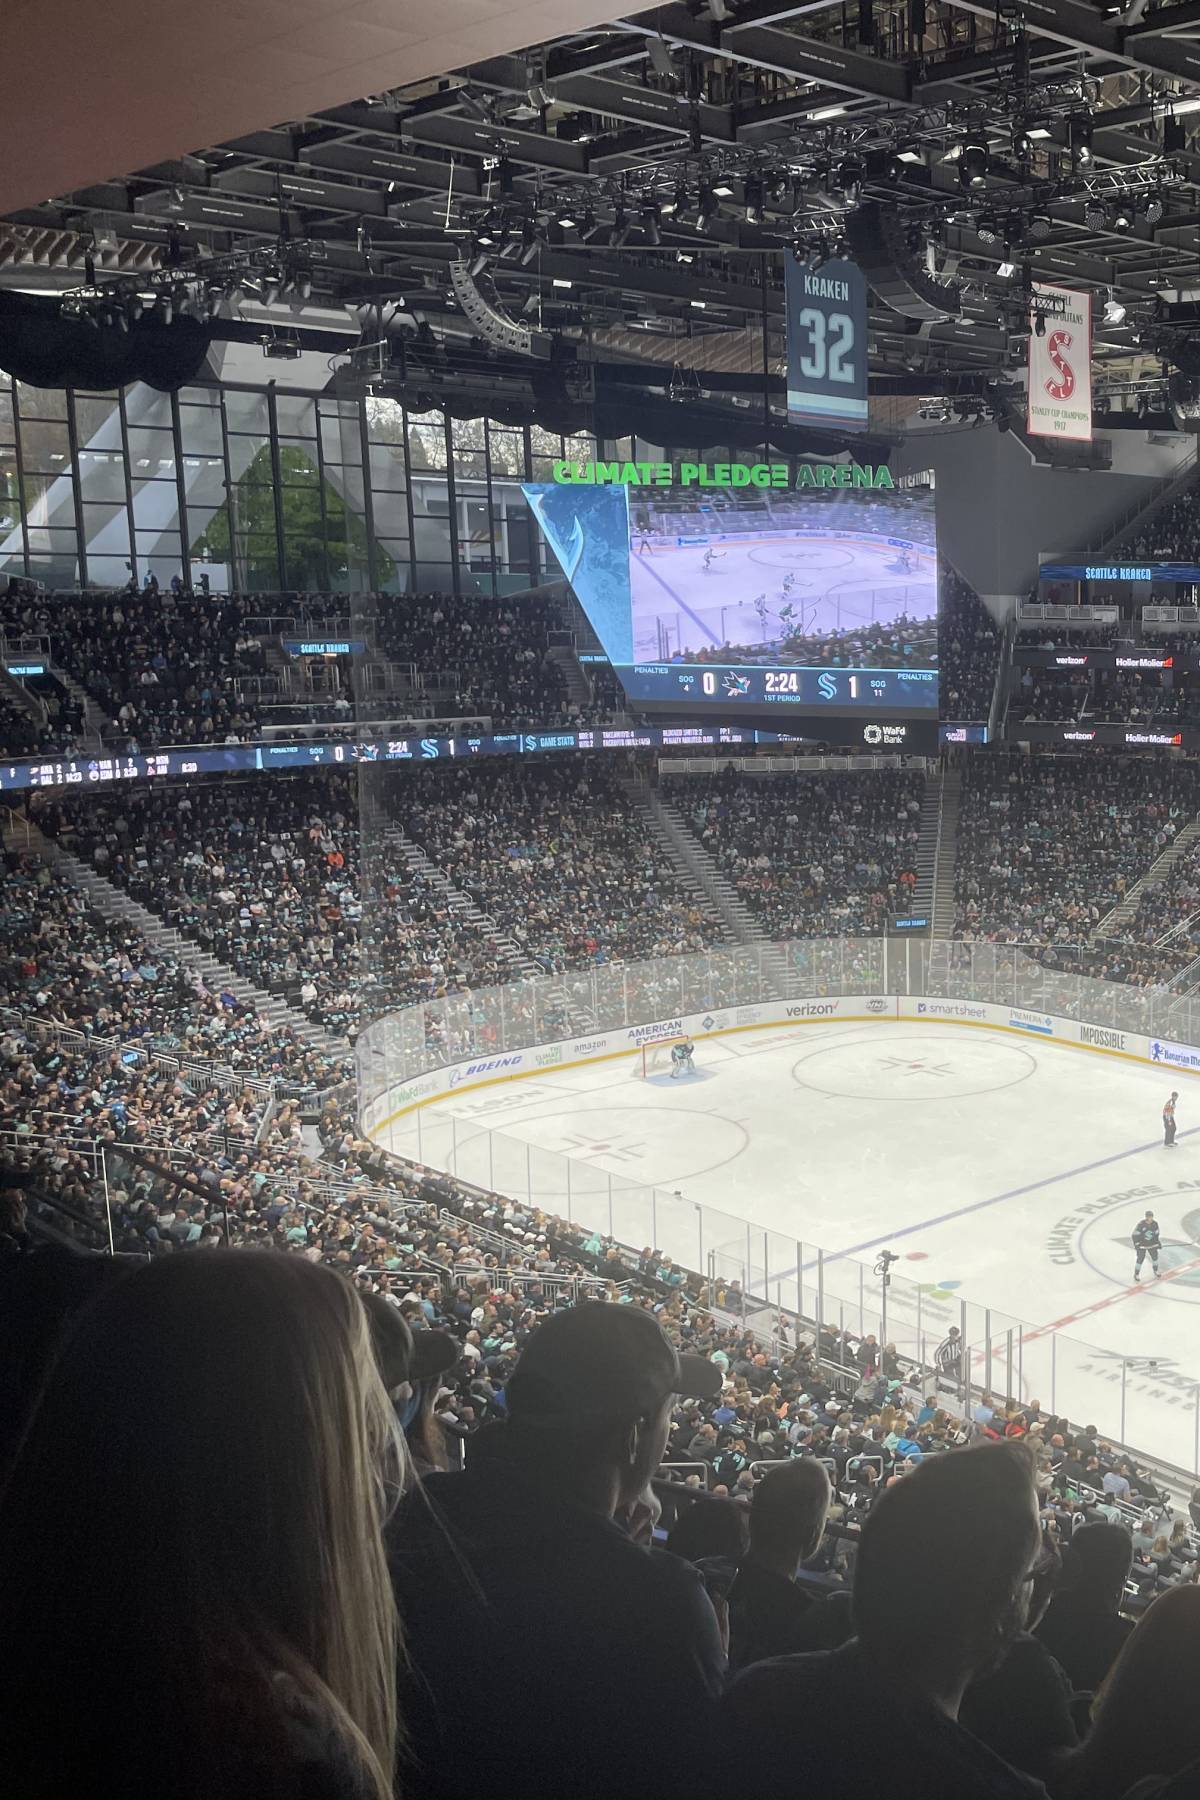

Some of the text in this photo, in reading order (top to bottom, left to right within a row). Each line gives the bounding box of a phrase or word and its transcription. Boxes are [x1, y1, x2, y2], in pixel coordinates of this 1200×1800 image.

[804, 274, 849, 301] KRAKEN
[800, 307, 855, 384] 32
[553, 461, 894, 489] CLIMATE PLEDGE ARENA
[1085, 567, 1151, 580] SEATTLE KRAKEN
[1056, 656, 1087, 666] verizon
[1116, 657, 1138, 667] Holier
[634, 665, 669, 675] PENALTIES
[678, 675, 695, 683] SOG
[703, 672, 715, 695] 0
[764, 672, 798, 693] 2:24
[897, 672, 933, 682] PENALTIES
[683, 684, 690, 692] 4
[848, 675, 857, 698] 1
[870, 680, 887, 689] SOG
[873, 689, 883, 697] 11
[882, 726, 906, 736] WaFd
[1064, 731, 1095, 741] verizon
[540, 737, 556, 747] GAME
[883, 735, 903, 744] Bank
[1126, 733, 1172, 744] Holier Molier
[335, 746, 343, 761] 0
[388, 741, 408, 753] 2:24
[448, 740, 455, 755] 1
[786, 1001, 838, 1017] verizon
[929, 1003, 986, 1019] smartsheet
[627, 1020, 682, 1038] AMERICAN
[1080, 1024, 1125, 1050] IMPOSSIBLE
[574, 1039, 606, 1053] amazon
[466, 1055, 522, 1077] BOEING
[1047, 1217, 1082, 1265] CLIMATE
[1080, 1184, 1163, 1215] PLEDGE
